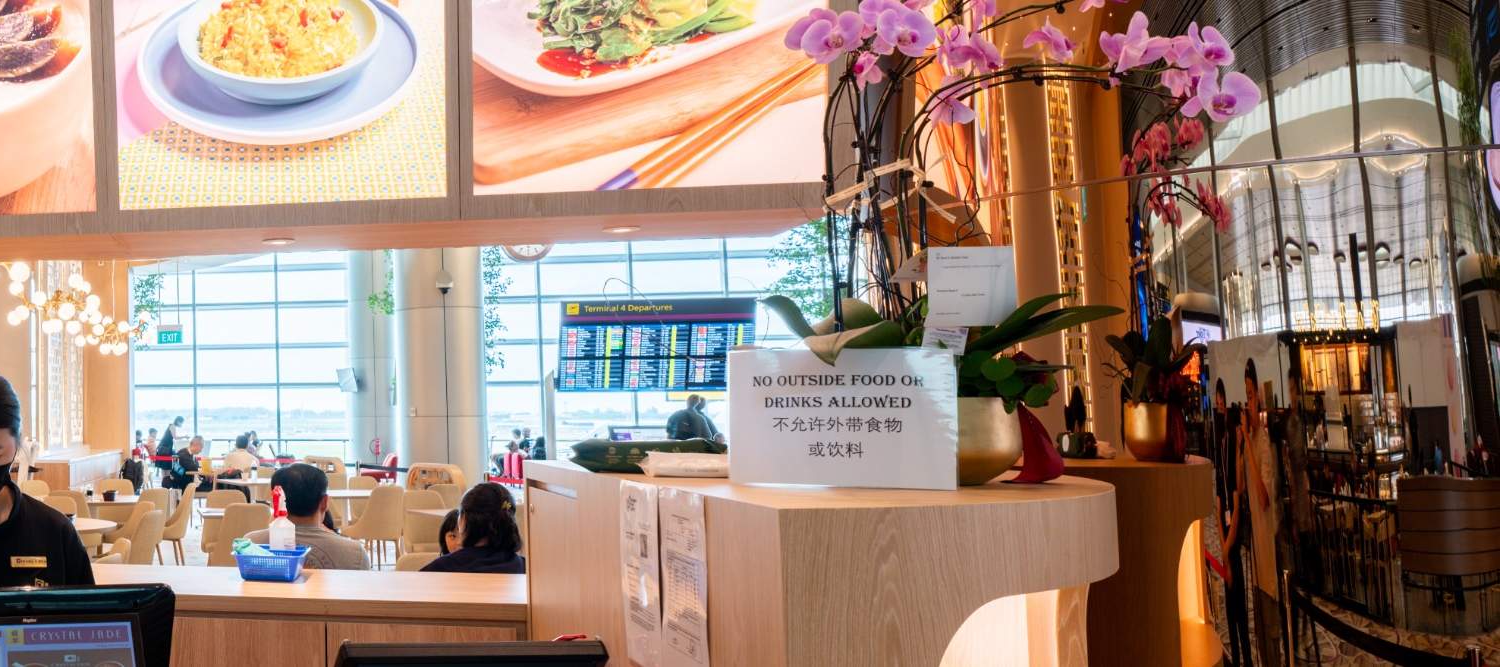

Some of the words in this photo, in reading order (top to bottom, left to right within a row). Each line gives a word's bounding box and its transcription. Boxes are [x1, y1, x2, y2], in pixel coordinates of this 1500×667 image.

[584, 304, 619, 313] Terminal
[620, 304, 626, 312] 4
[627, 304, 673, 313] Departures
[162, 333, 177, 342] EXIT
[753, 376, 772, 386] NO
[776, 374, 846, 387] OUTSIDE
[851, 374, 896, 387] FOOD
[901, 374, 924, 388] OR
[764, 396, 823, 409] DRINKS
[827, 394, 912, 409] ALLOWED
[772, 416, 903, 433] 不允许外带食物
[808, 441, 864, 459] 或饮料
[30, 629, 83, 641] CRYSTAL
[91, 629, 123, 640] JADE
